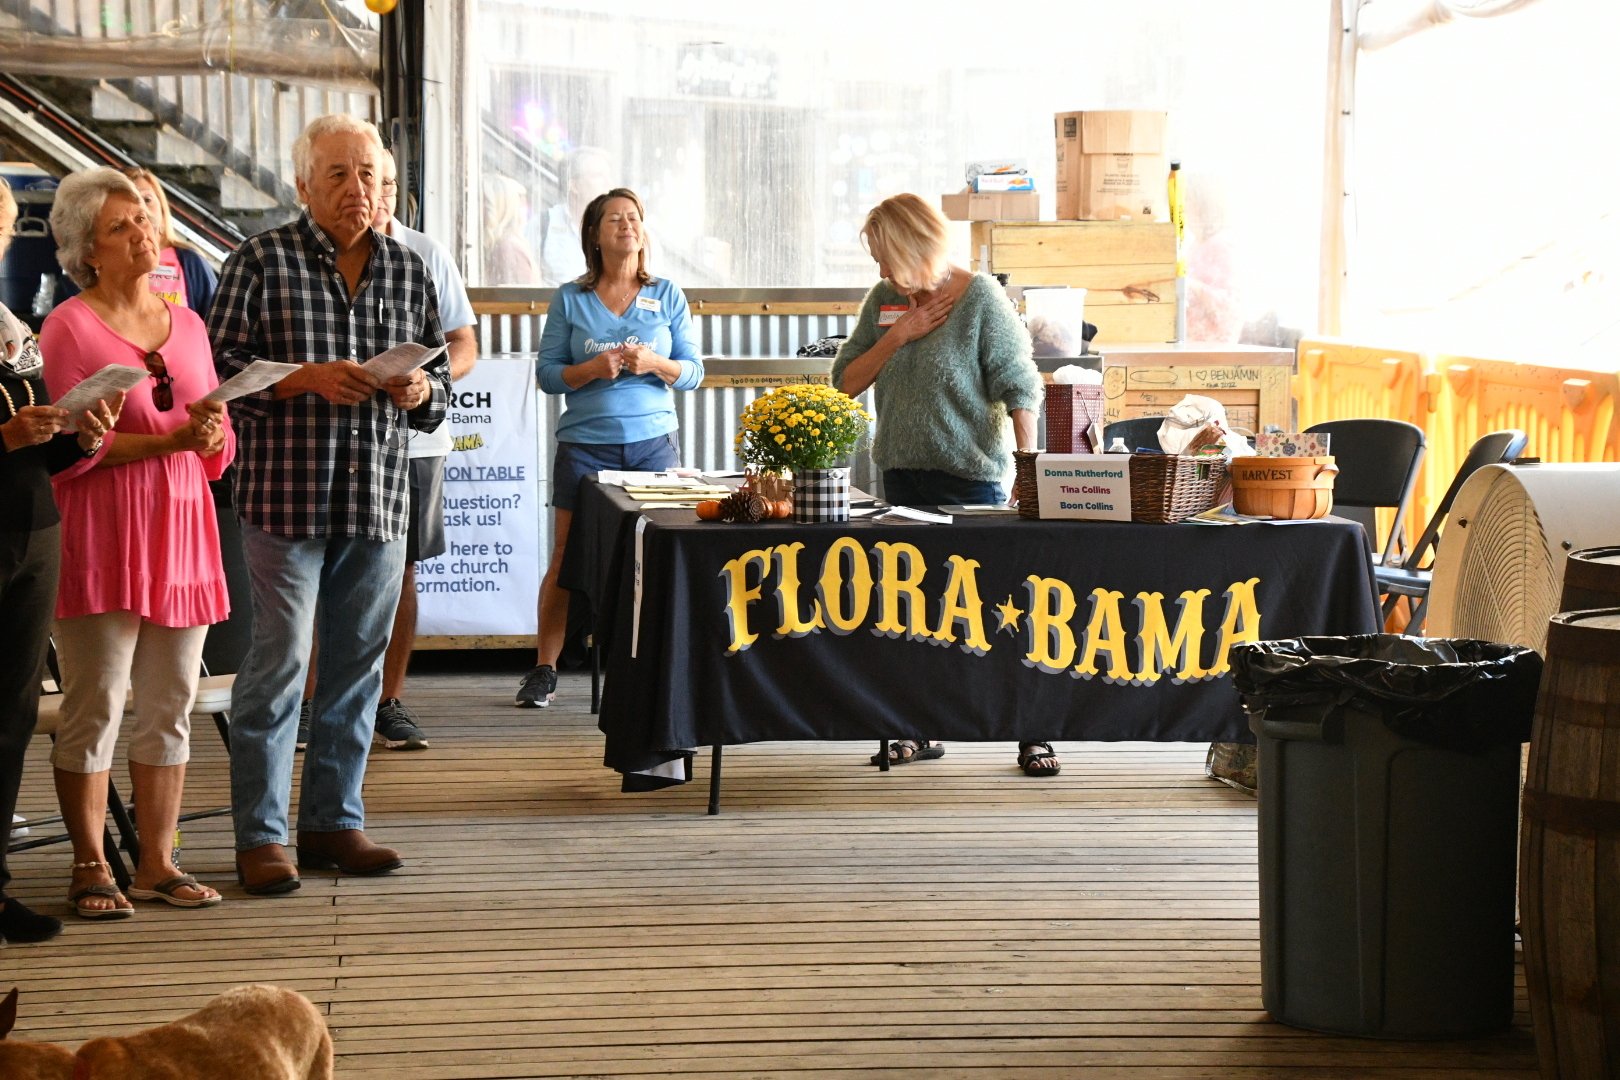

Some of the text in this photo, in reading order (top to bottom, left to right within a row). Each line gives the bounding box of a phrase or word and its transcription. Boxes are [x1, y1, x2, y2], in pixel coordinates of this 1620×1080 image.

[1210, 369, 1260, 382] BENJAMIN
[476, 465, 525, 481] TABLE
[1044, 469, 1123, 478] Donna Rutherford
[1242, 468, 1293, 480] HARVEST
[1060, 485, 1111, 495] Tina Collins
[1060, 501, 1114, 511] Boon Collins
[476, 510, 502, 527] us!
[450, 541, 513, 556] here to
[450, 558, 509, 575] church
[718, 536, 1262, 688] FLORA BAMA
